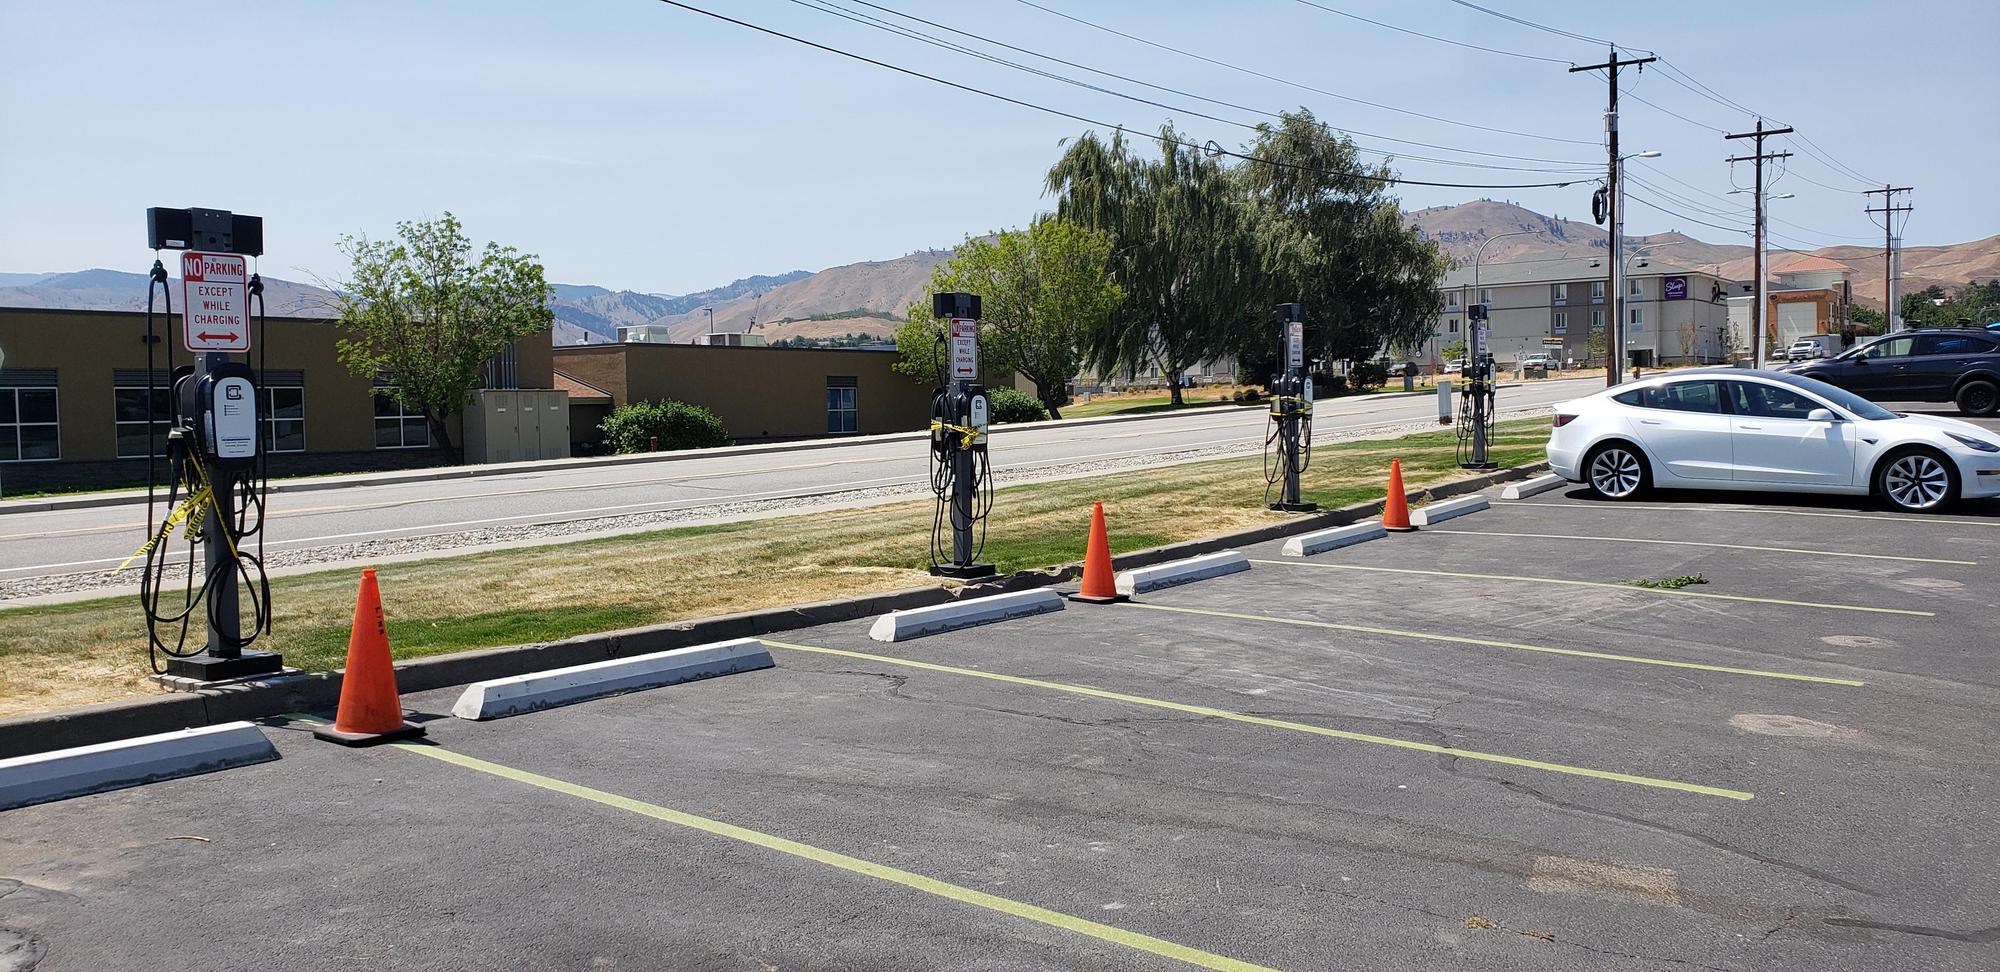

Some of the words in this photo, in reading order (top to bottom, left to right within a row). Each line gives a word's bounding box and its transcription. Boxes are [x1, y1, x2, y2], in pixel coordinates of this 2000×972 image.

[184, 257, 202, 277] NO
[204, 262, 243, 276] PARKING
[198, 286, 233, 297] EXCEPT
[202, 300, 231, 311] WHILE
[194, 314, 240, 325] CHARGING
